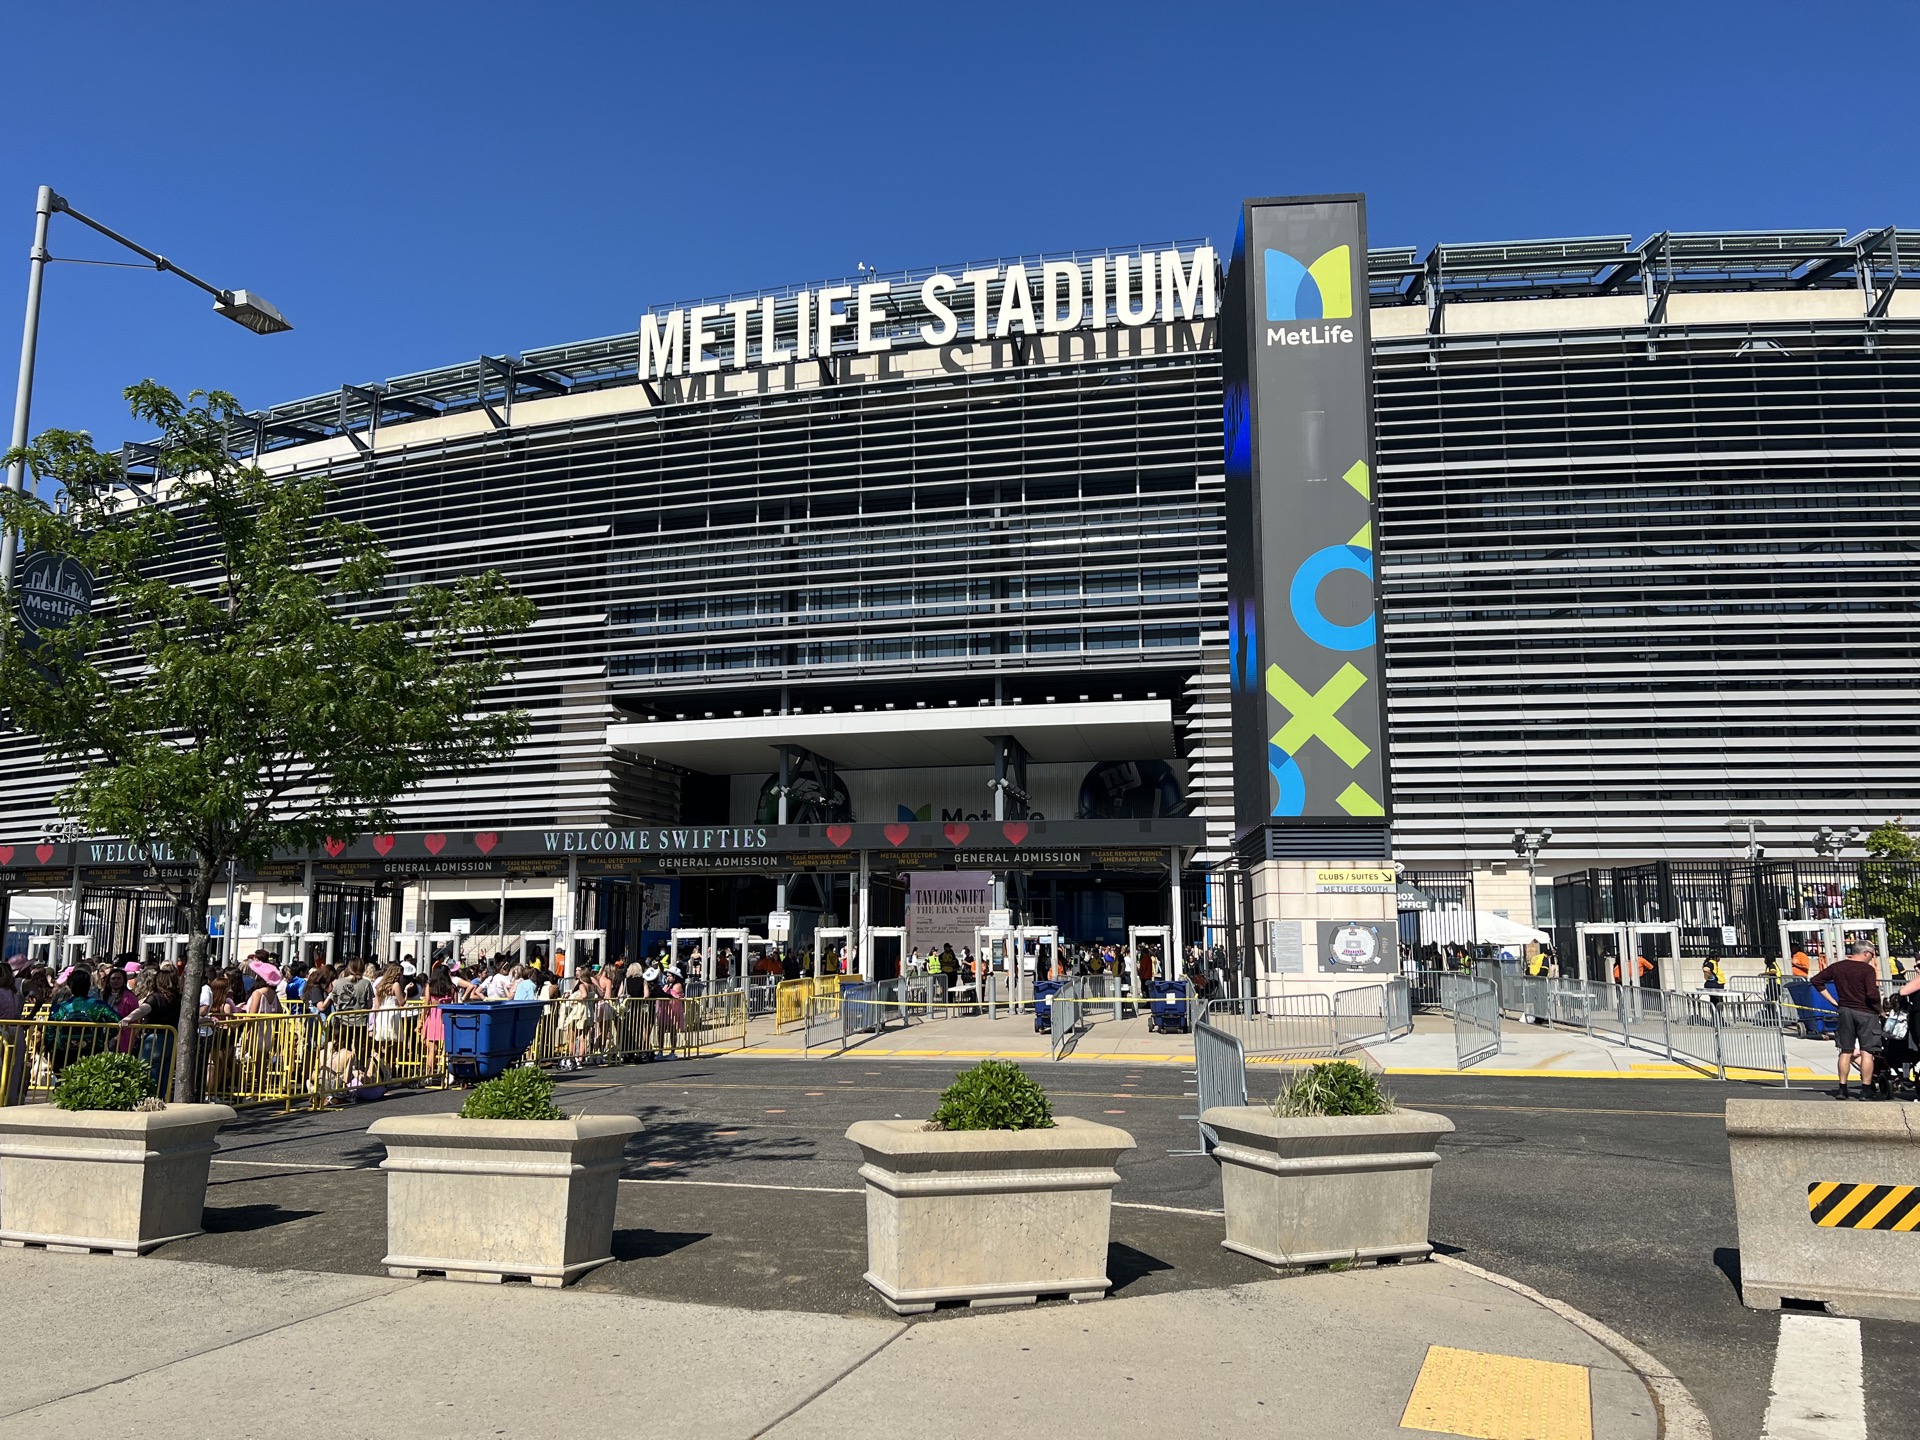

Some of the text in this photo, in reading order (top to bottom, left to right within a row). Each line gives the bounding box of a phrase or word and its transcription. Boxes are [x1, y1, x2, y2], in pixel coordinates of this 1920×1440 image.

[638, 247, 1216, 380] METLIFE STADIUM
[1267, 325, 1353, 346] MetLife
[26, 594, 83, 616] MetLife
[543, 828, 767, 851] WELCOME SWIFTIES
[658, 856, 778, 868] GENERAL ADMISSION
[954, 852, 1081, 863] GENERAL ADMISSION
[143, 868, 183, 878] GEERAL
[384, 862, 492, 873] GENERAL ADMISSION
[1323, 885, 1388, 893] METLIFE SOUTH
[916, 889, 986, 906] TAYLOR SWIFT
[916, 906, 986, 914] THE ERAS TOUR
[1397, 901, 1428, 909] OFFICE
